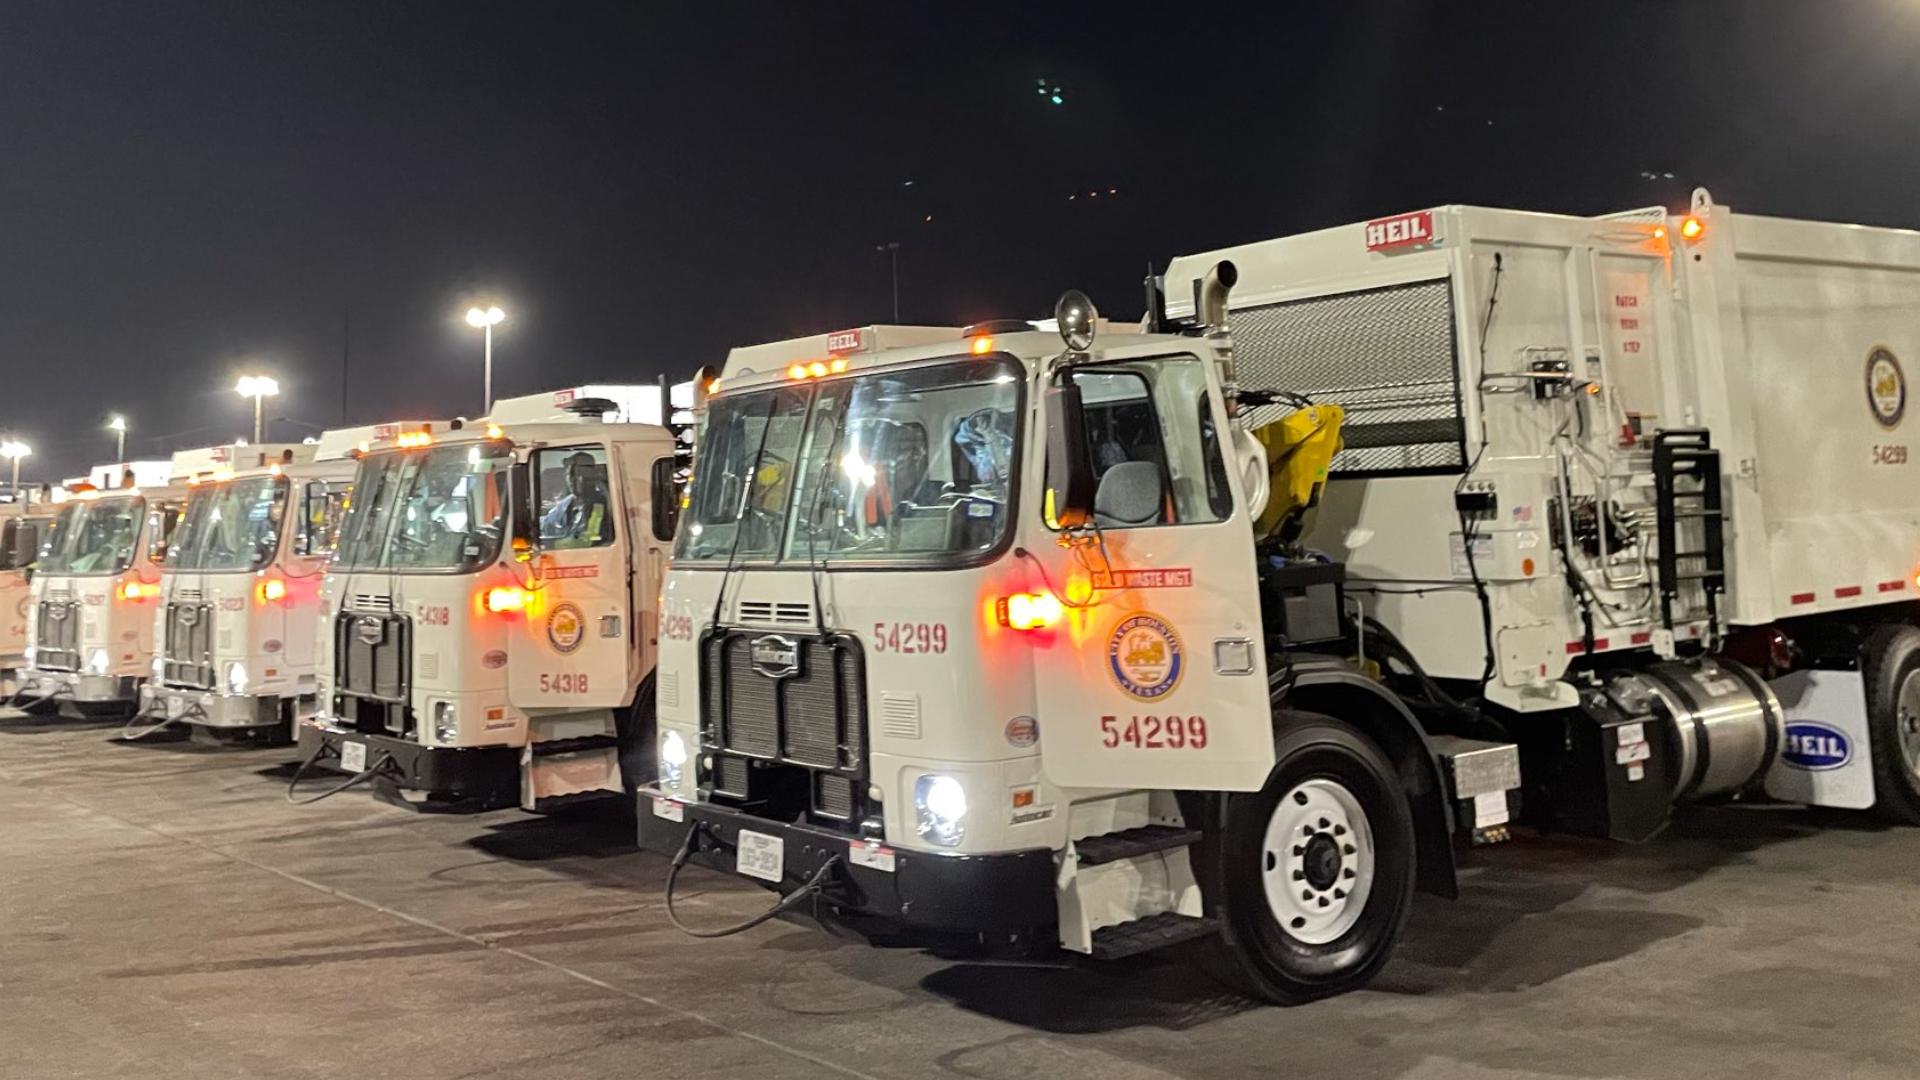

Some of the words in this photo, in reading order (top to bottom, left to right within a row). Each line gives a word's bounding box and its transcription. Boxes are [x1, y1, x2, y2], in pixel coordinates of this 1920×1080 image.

[1367, 217, 1427, 247] HEIL
[829, 334, 858, 350] HEIL
[1872, 445, 1907, 464] 54299
[418, 605, 449, 626] 54318
[874, 622, 947, 654] 54299
[540, 673, 588, 694] 54318
[1101, 715, 1207, 749] 54299
